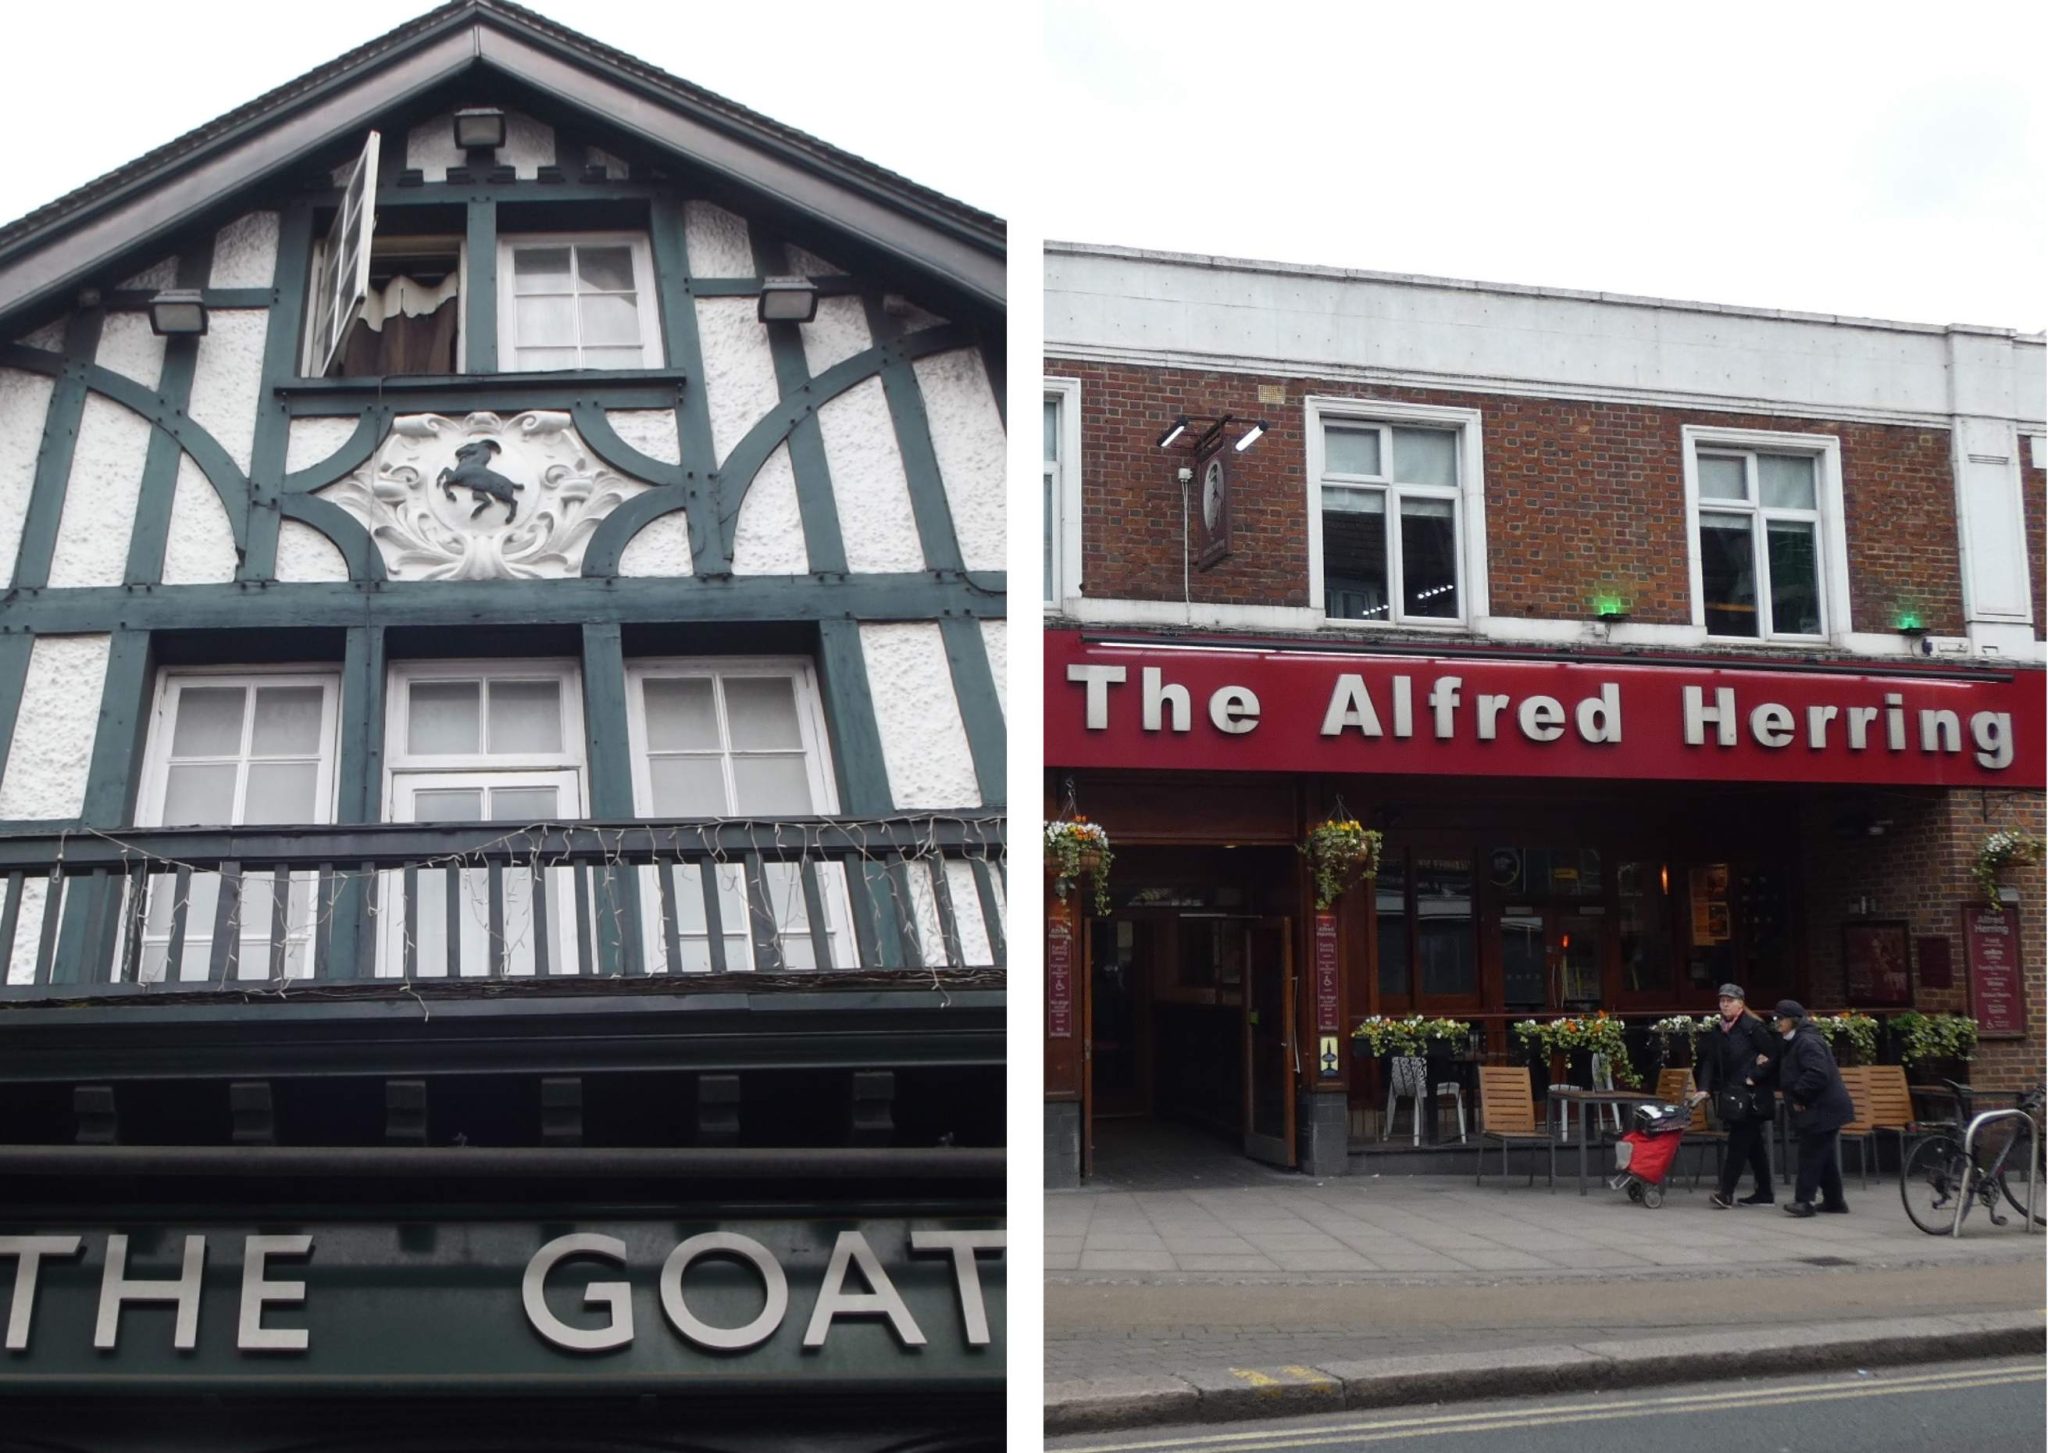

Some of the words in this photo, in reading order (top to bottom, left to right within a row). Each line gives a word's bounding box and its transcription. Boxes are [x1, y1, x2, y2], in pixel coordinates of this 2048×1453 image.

[1066, 664, 1261, 734] The
[1320, 673, 1622, 745] Alfred
[1683, 685, 2015, 772] Herring
[0, 1234, 314, 1350] THE
[522, 1230, 1007, 1351] GOAT
